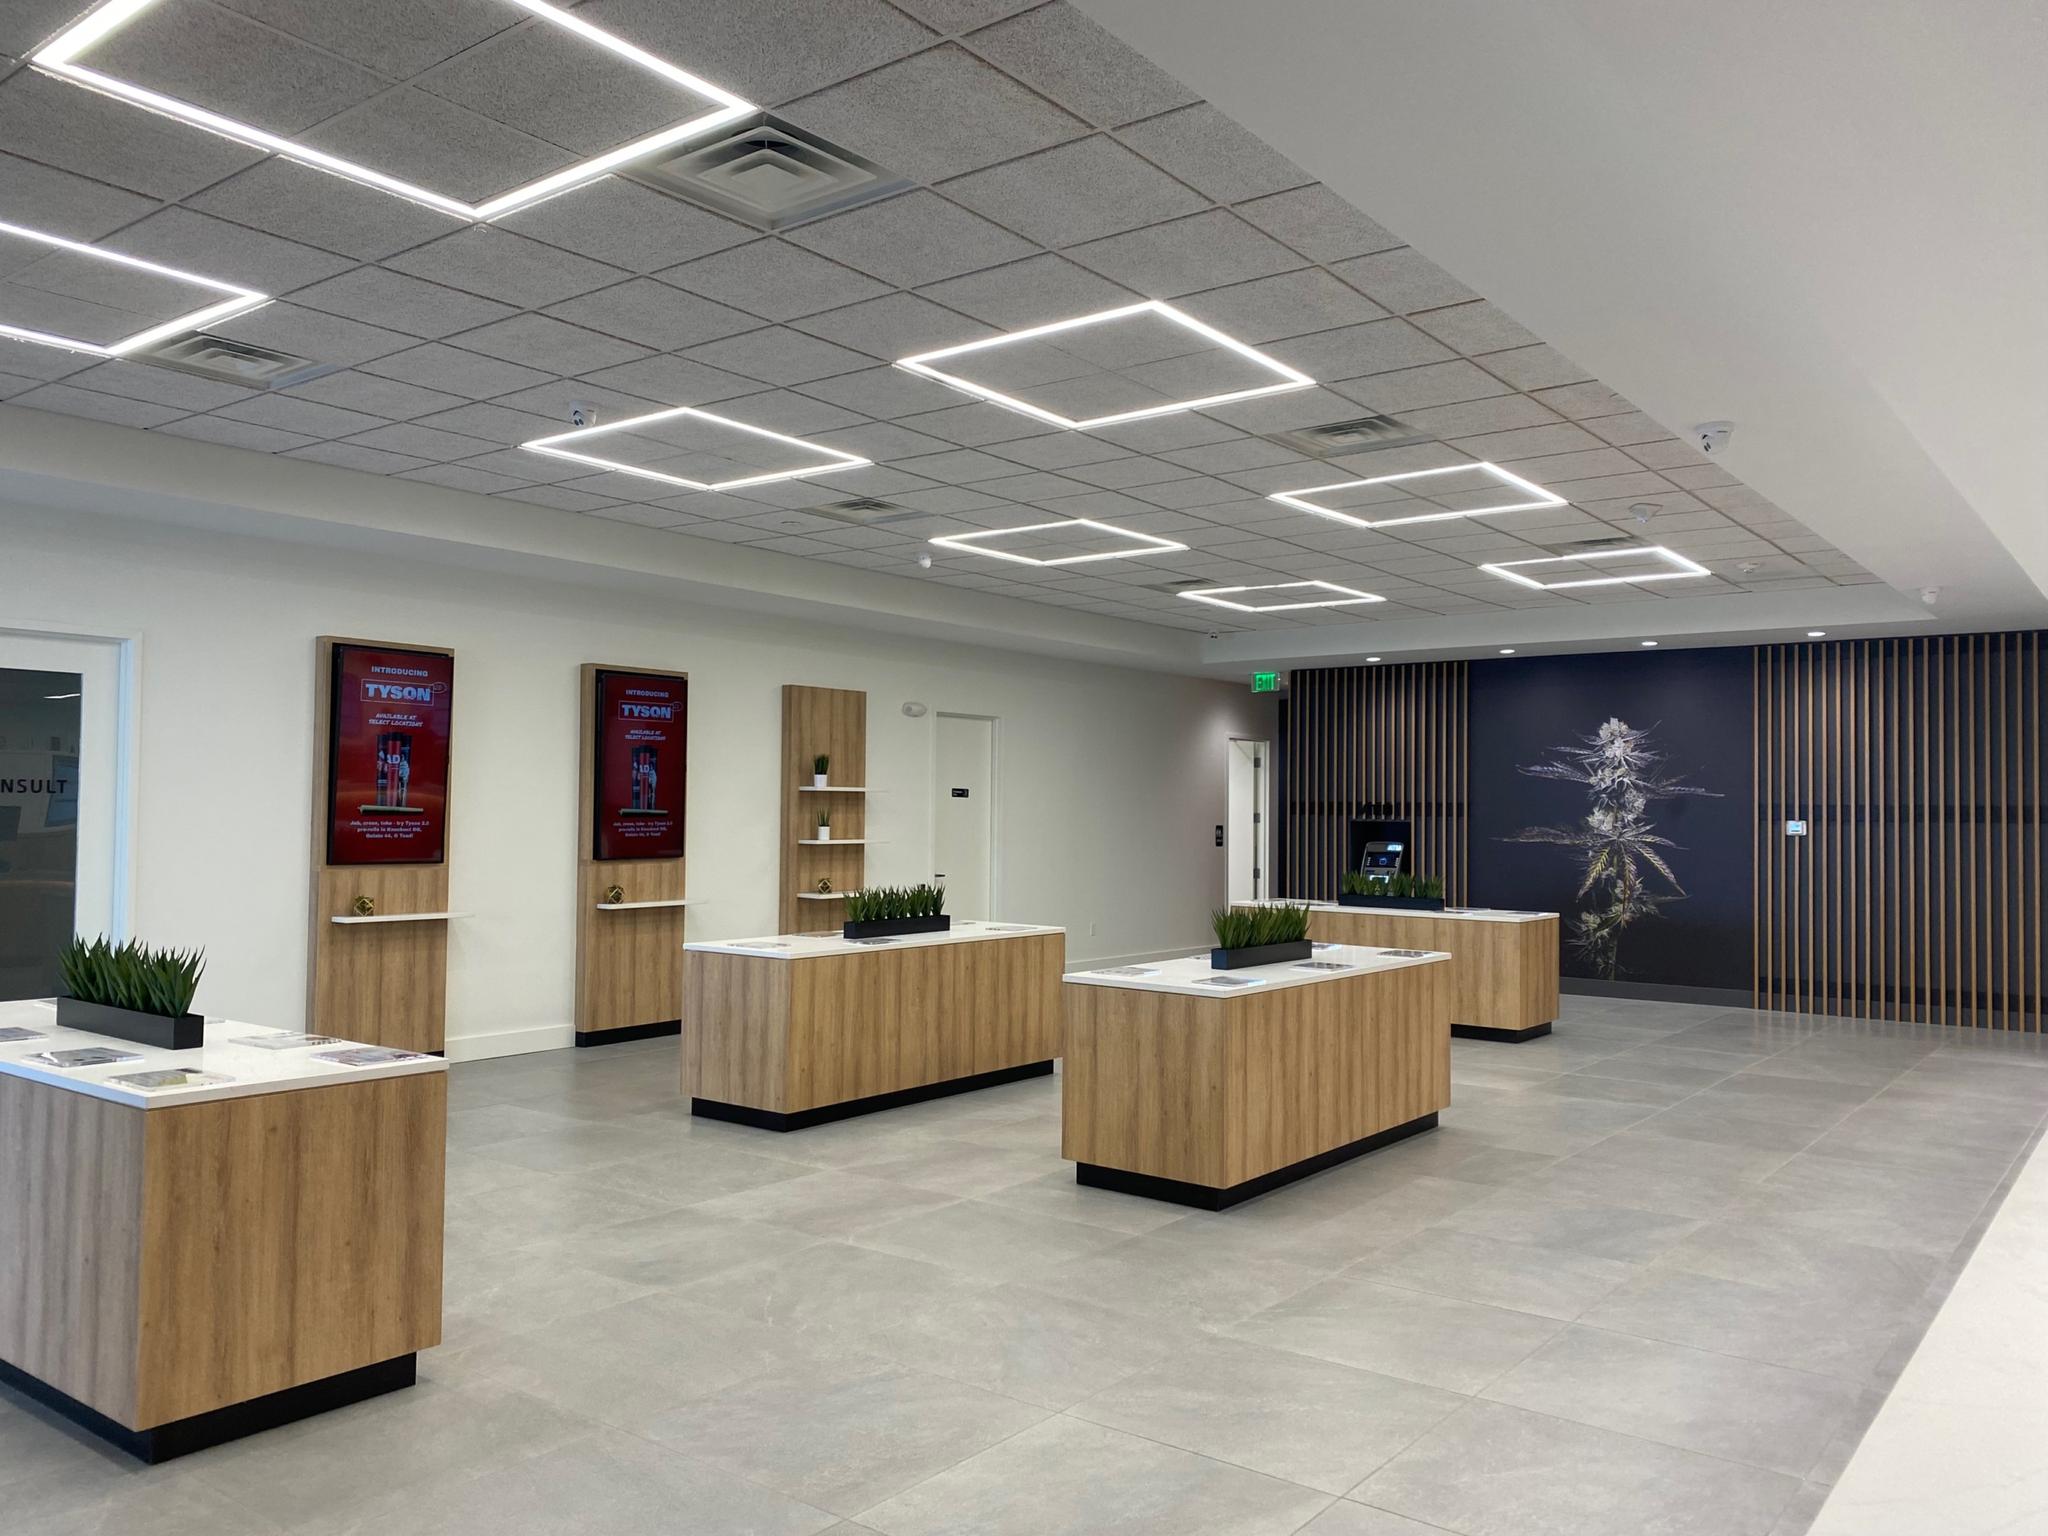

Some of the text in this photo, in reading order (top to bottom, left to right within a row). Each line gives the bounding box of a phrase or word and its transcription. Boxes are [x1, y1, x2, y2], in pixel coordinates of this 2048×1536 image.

[371, 665, 428, 677] INTRODUCING
[1256, 674, 1275, 691] EXIT
[365, 683, 431, 702] TYSON
[625, 689, 669, 698] INTRODUCING
[621, 704, 671, 719] TYSON
[0, 779, 67, 794] NSULT
